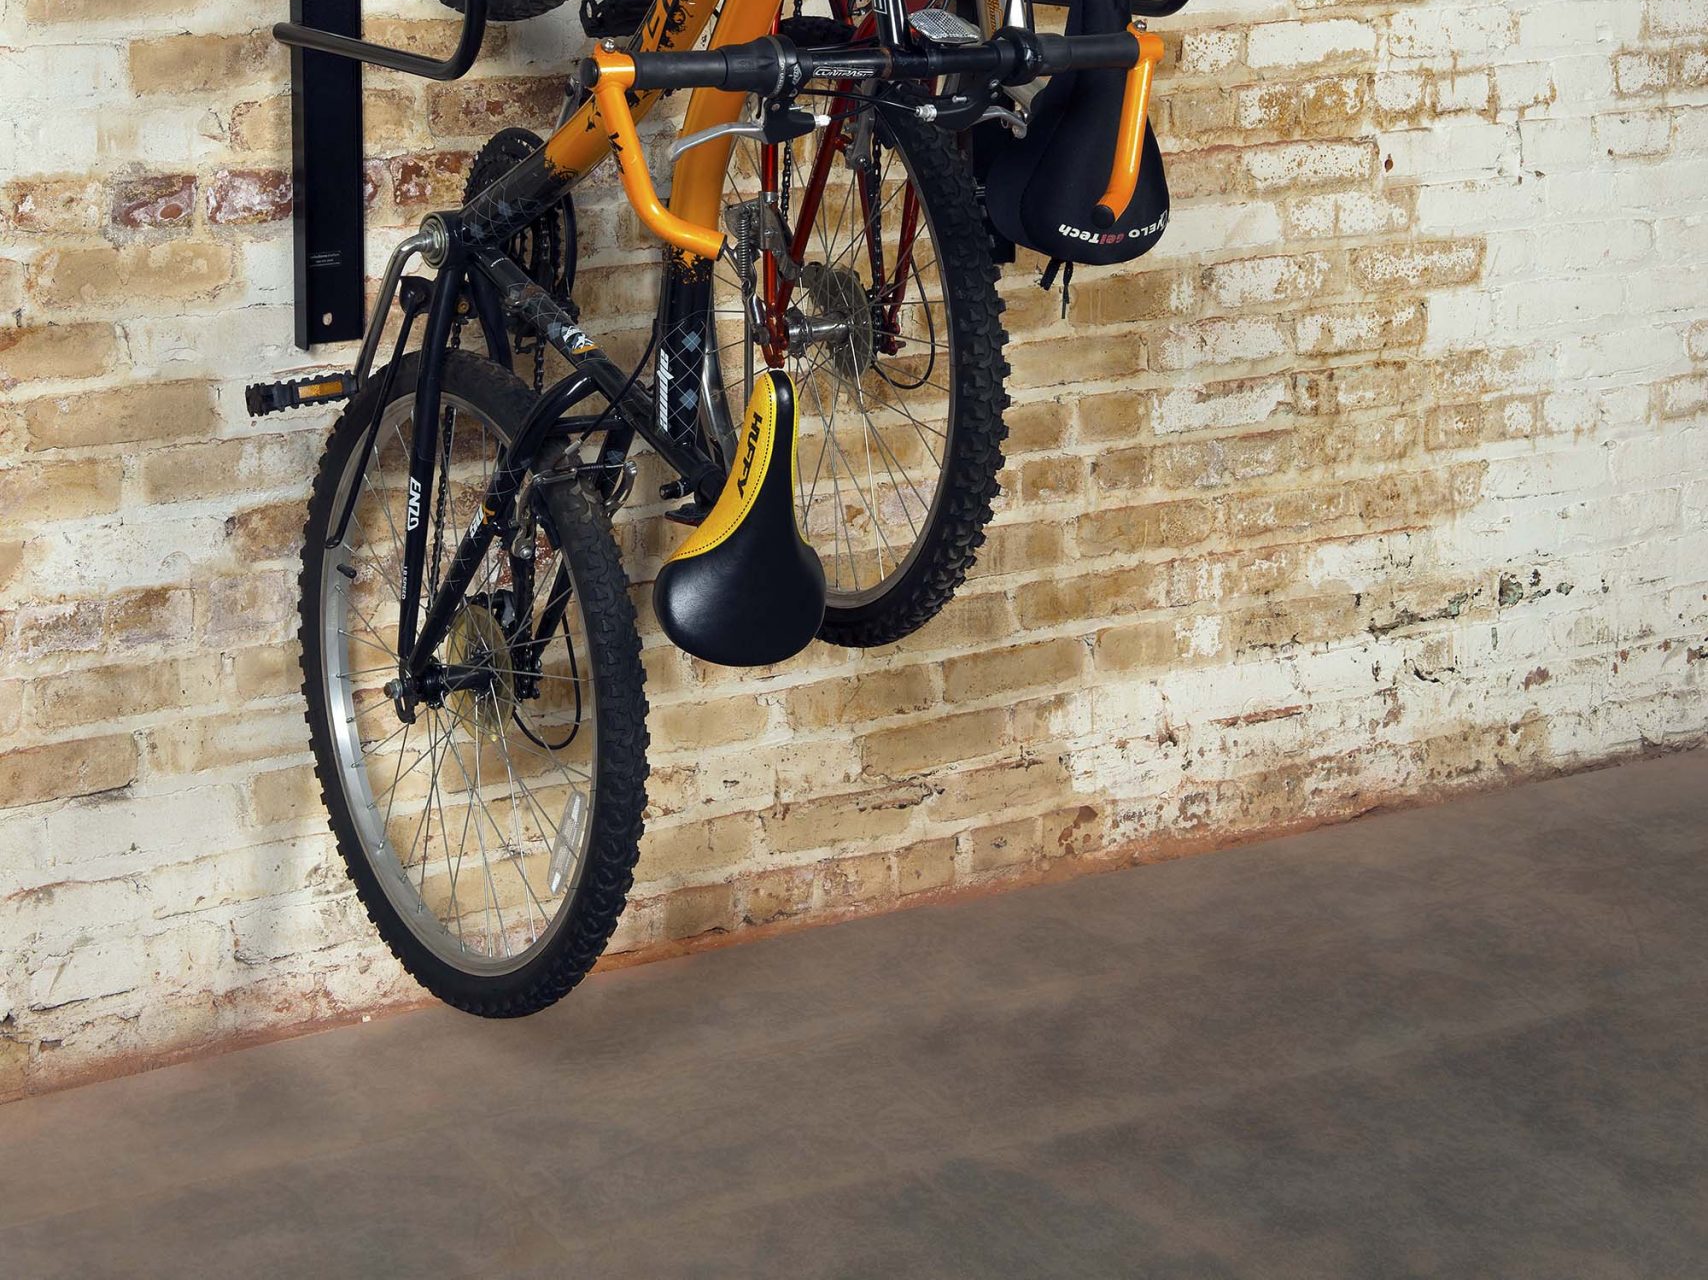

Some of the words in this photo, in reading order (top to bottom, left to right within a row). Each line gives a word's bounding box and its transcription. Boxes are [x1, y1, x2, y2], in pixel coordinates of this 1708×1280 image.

[656, 348, 674, 432] alpine
[737, 412, 763, 499] HUFFY
[407, 476, 422, 532] ENZO
